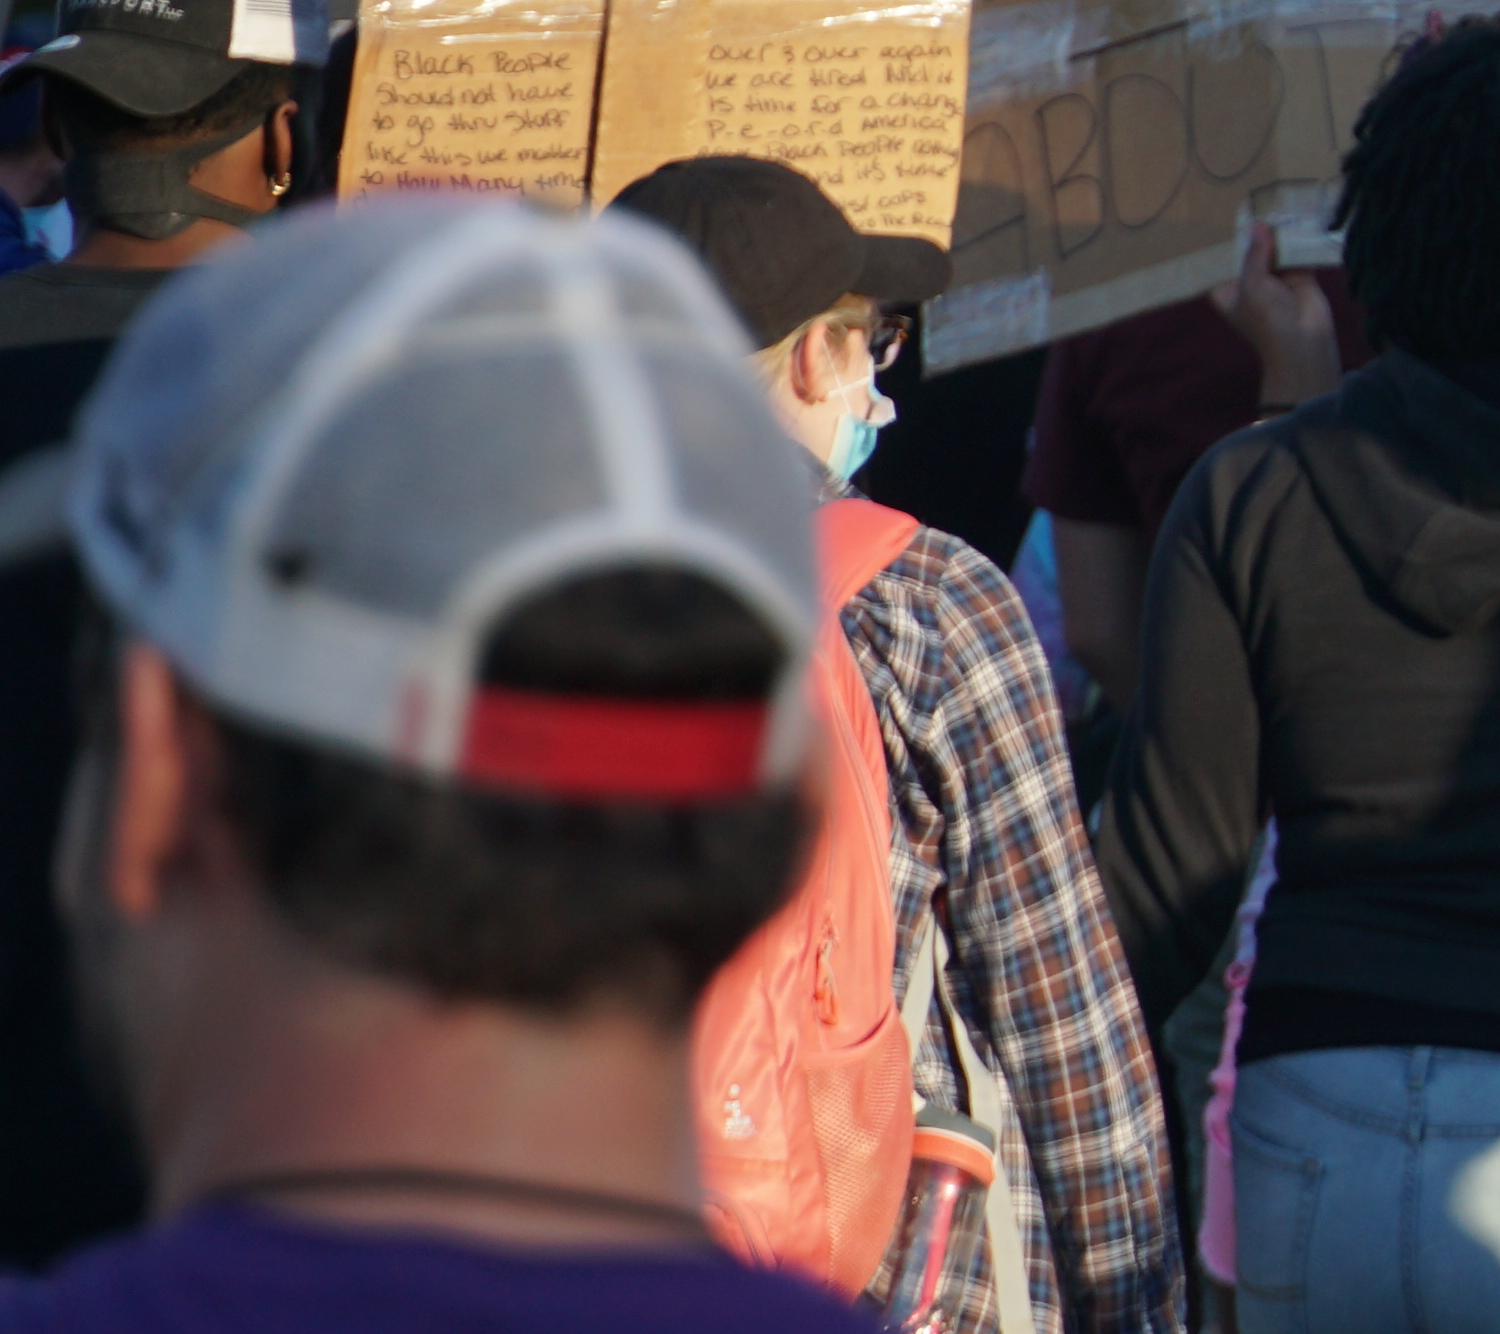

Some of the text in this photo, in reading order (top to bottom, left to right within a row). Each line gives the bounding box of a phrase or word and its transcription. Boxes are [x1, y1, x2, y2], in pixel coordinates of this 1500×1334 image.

[373, 111, 395, 131] to
[406, 115, 434, 147] go
[420, 146, 472, 166] this
